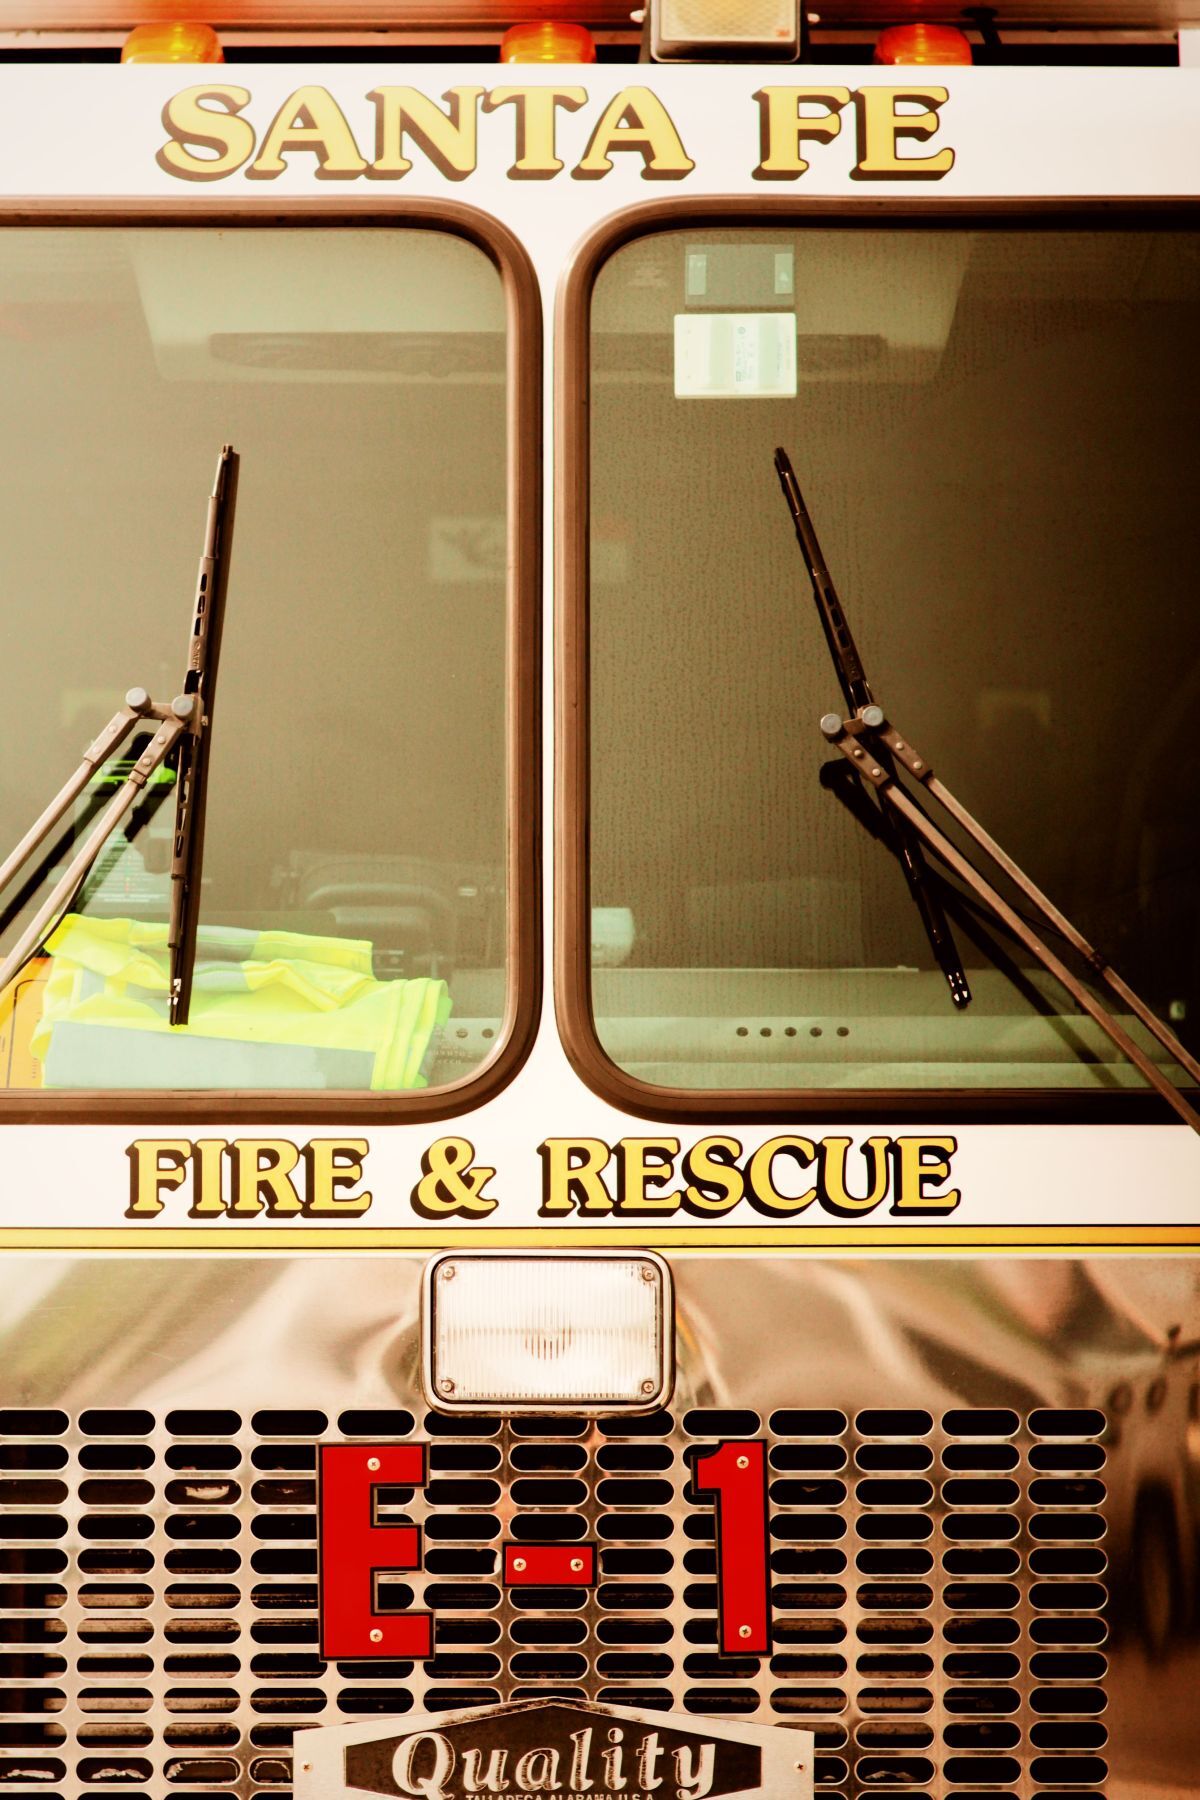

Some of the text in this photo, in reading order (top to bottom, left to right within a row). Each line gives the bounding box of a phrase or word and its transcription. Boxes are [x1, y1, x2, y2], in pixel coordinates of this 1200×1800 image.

[155, 83, 956, 182] SANTA FE
[124, 1135, 961, 1220] FIRE & RESCUE
[392, 1727, 716, 1800] Quality
